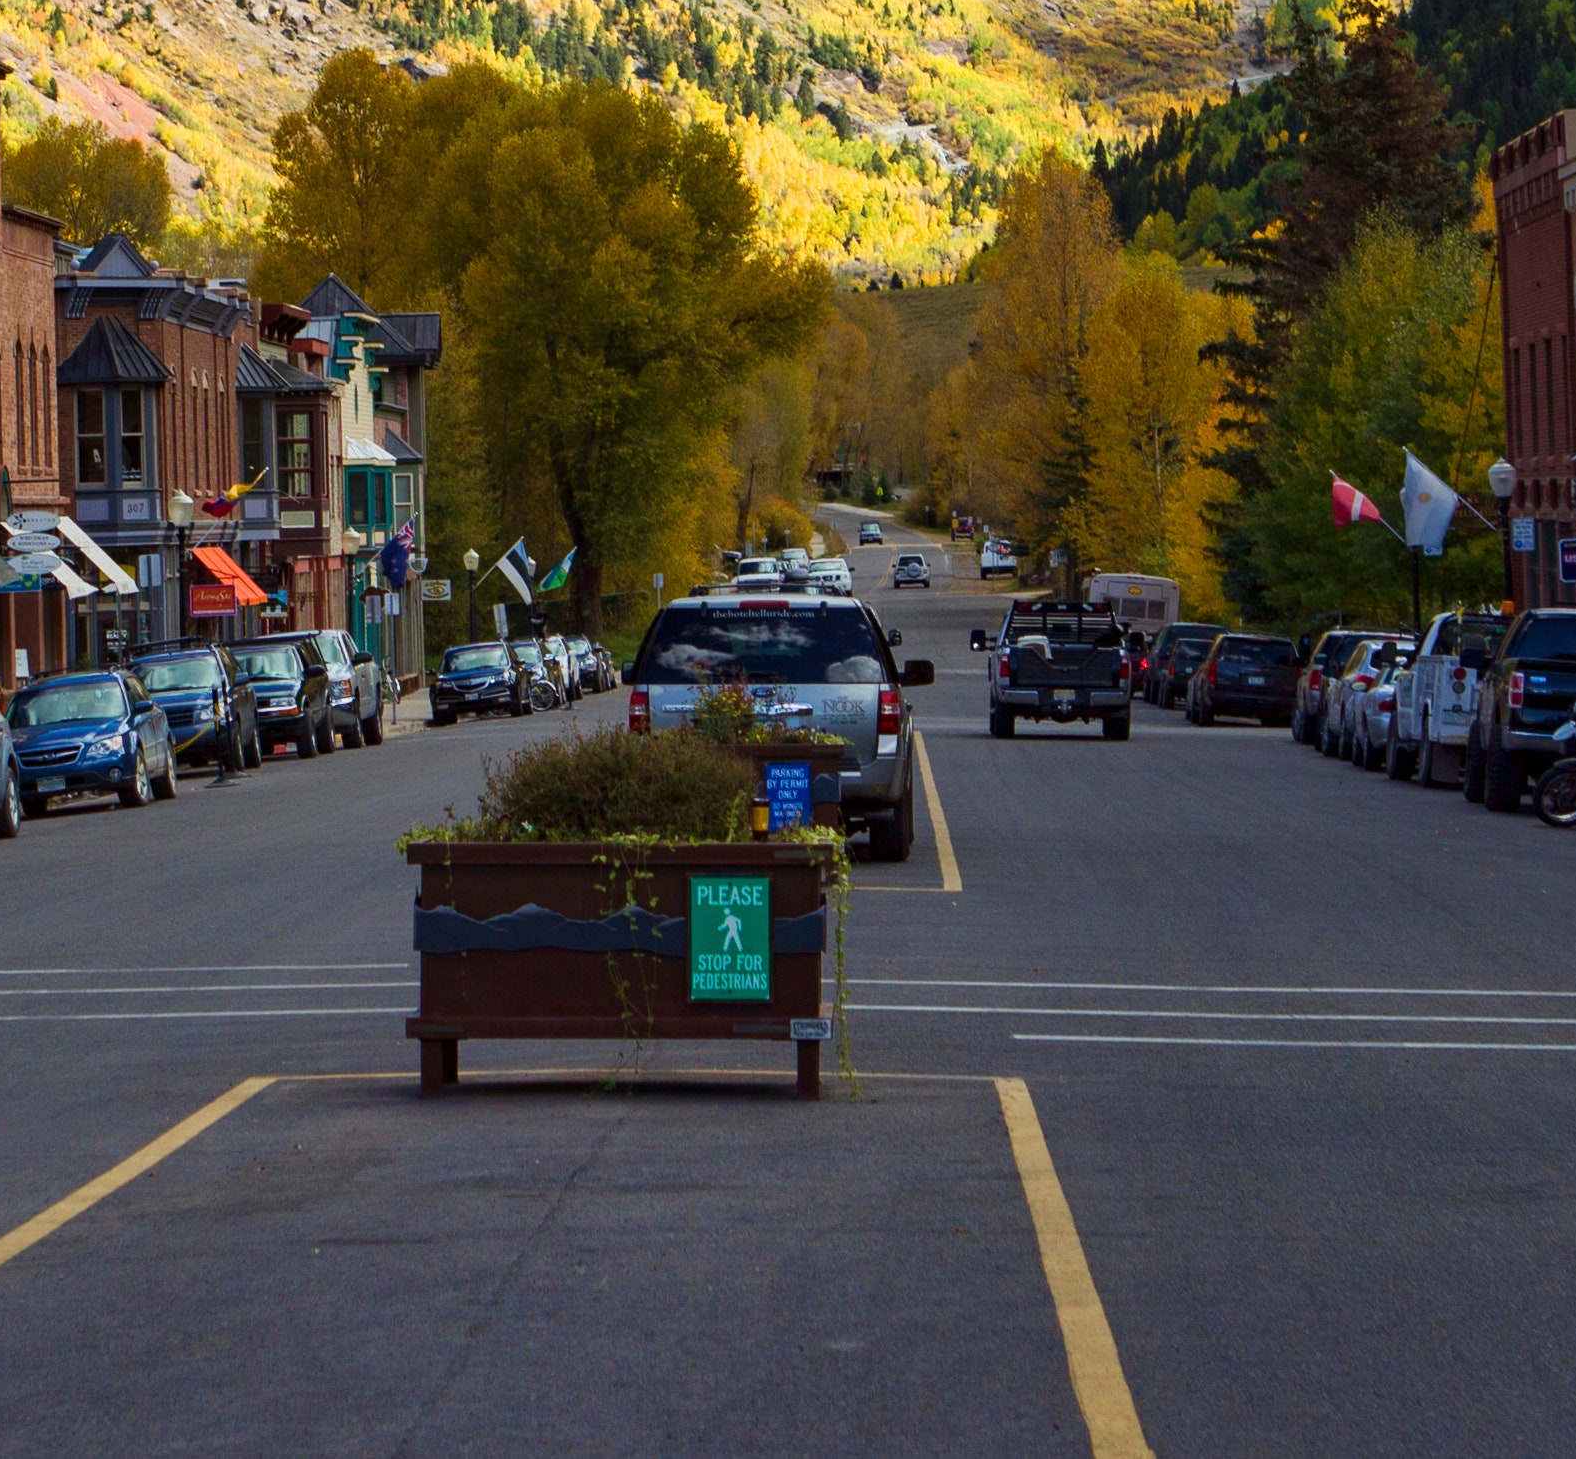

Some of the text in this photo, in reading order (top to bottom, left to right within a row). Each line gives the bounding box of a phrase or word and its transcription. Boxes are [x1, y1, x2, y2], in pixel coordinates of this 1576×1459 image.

[127, 503, 145, 514] 307
[712, 609, 815, 620] thehoteltelluride.com
[823, 700, 865, 714] NOOK
[771, 768, 805, 778] PARKING
[767, 778, 809, 789] BY PERMIT
[777, 790, 798, 800] ONLY
[697, 885, 763, 906] PLEASE
[697, 954, 763, 971] STOP FOR
[692, 972, 768, 990] PEDESTRIANS
